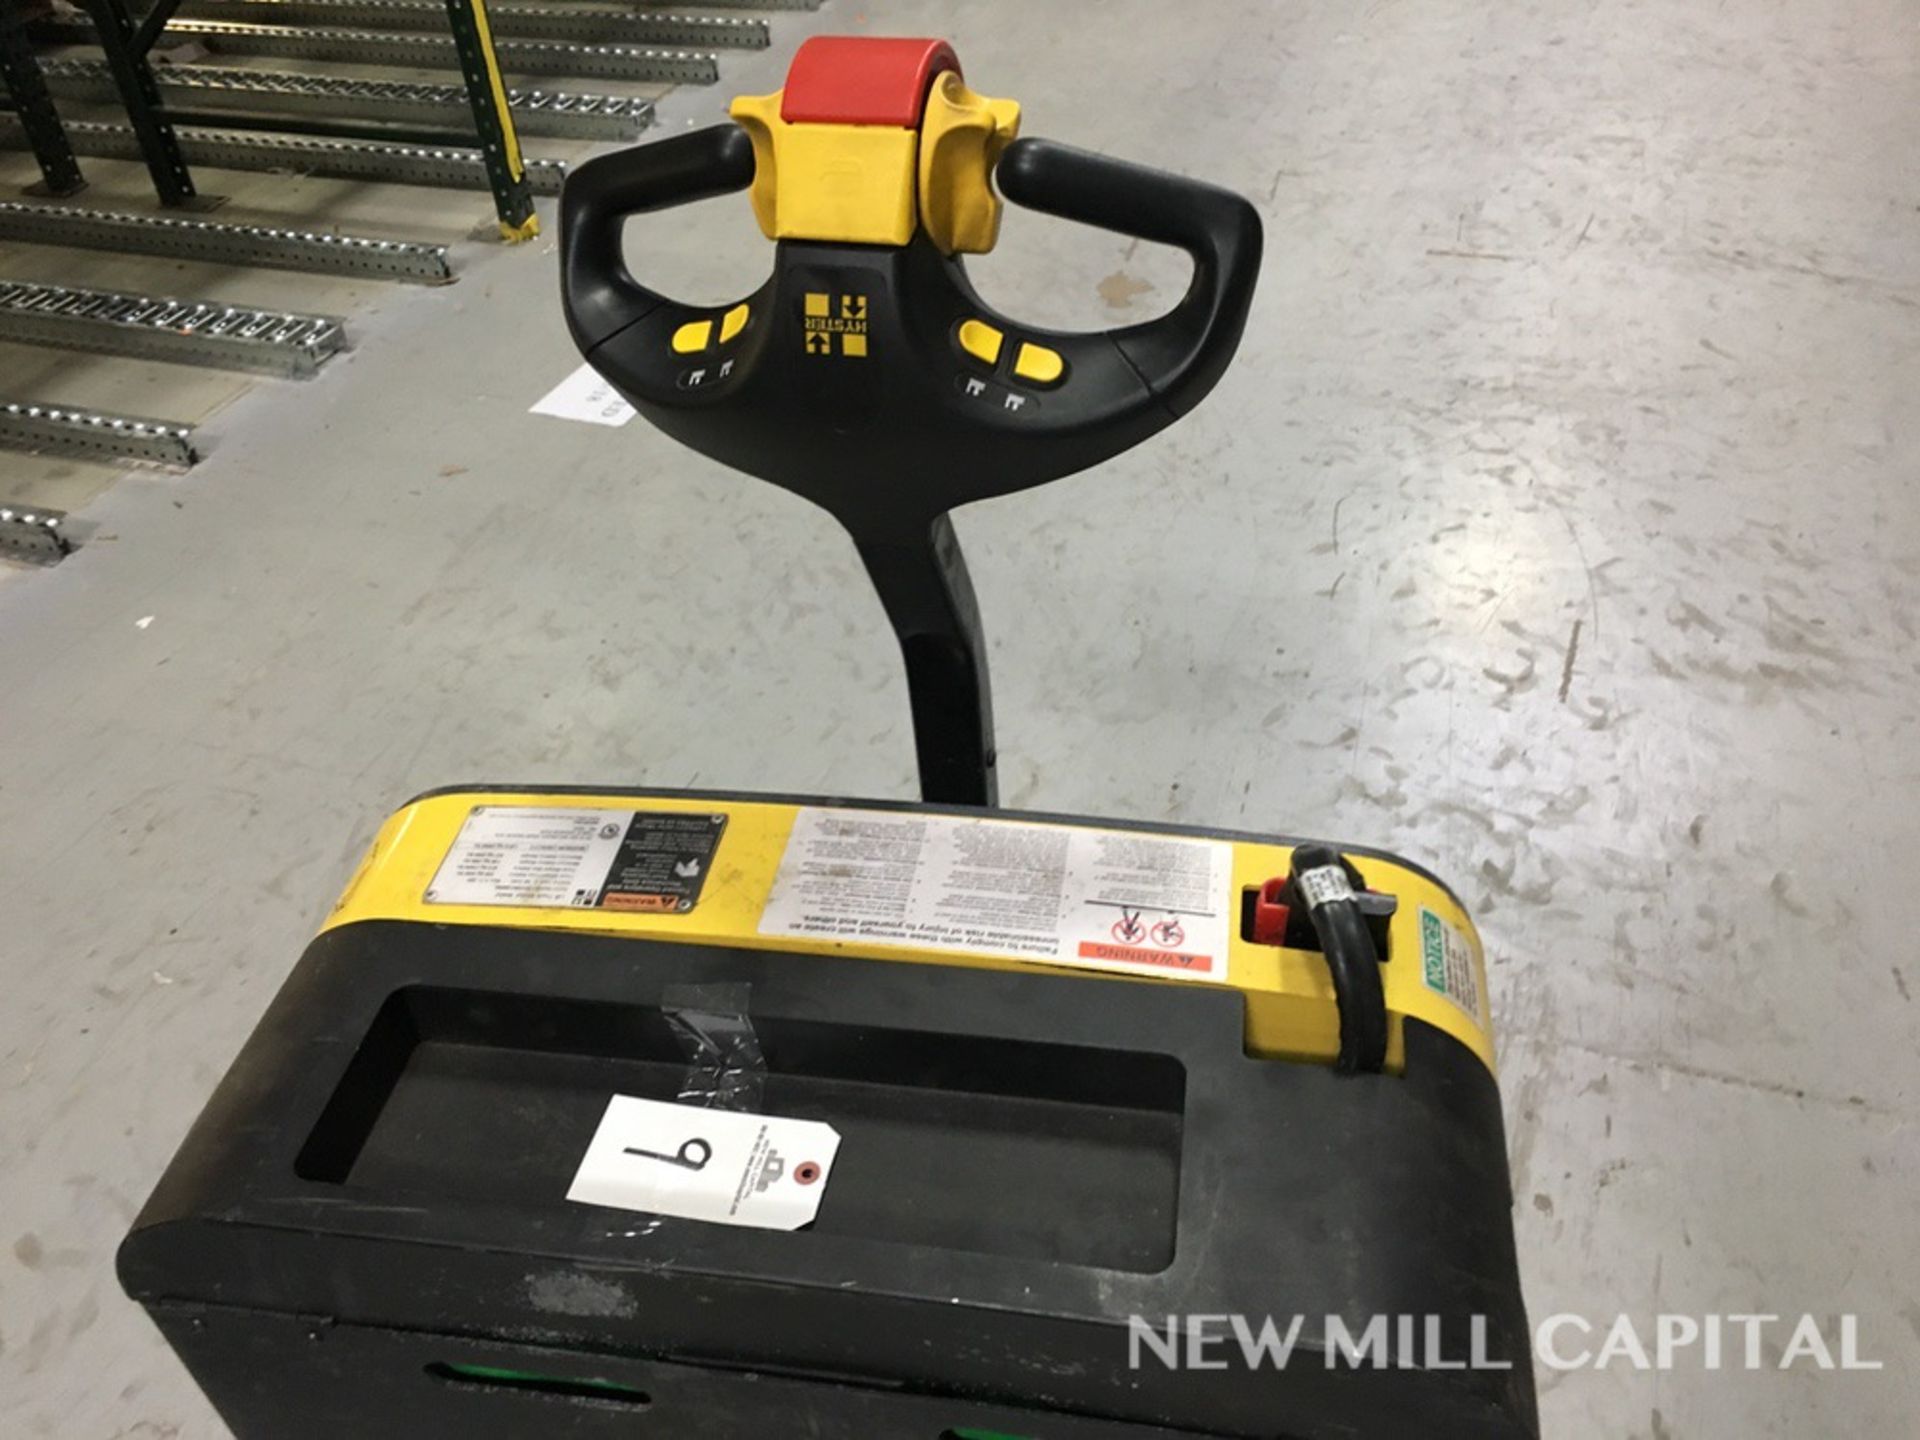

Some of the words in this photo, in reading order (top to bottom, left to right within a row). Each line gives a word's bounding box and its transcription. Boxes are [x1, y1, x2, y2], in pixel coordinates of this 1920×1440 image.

[804, 318, 868, 334] HYSTER
[604, 896, 656, 905] WARNING
[837, 917, 858, 926] and
[859, 917, 903, 930] yourself
[803, 923, 836, 933] create
[836, 926, 856, 935] will
[903, 923, 916, 931] to
[918, 923, 949, 934] injury
[950, 927, 962, 936] of
[857, 926, 907, 939] warnings
[908, 933, 938, 942] these
[964, 929, 985, 938] risk
[940, 936, 963, 945] with
[965, 936, 1005, 949] comply
[986, 931, 1059, 945] unreasonable
[1006, 942, 1018, 950] to
[1020, 943, 1058, 954] Failure
[1094, 945, 1174, 965] WARNING
[622, 1137, 712, 1171] 9
